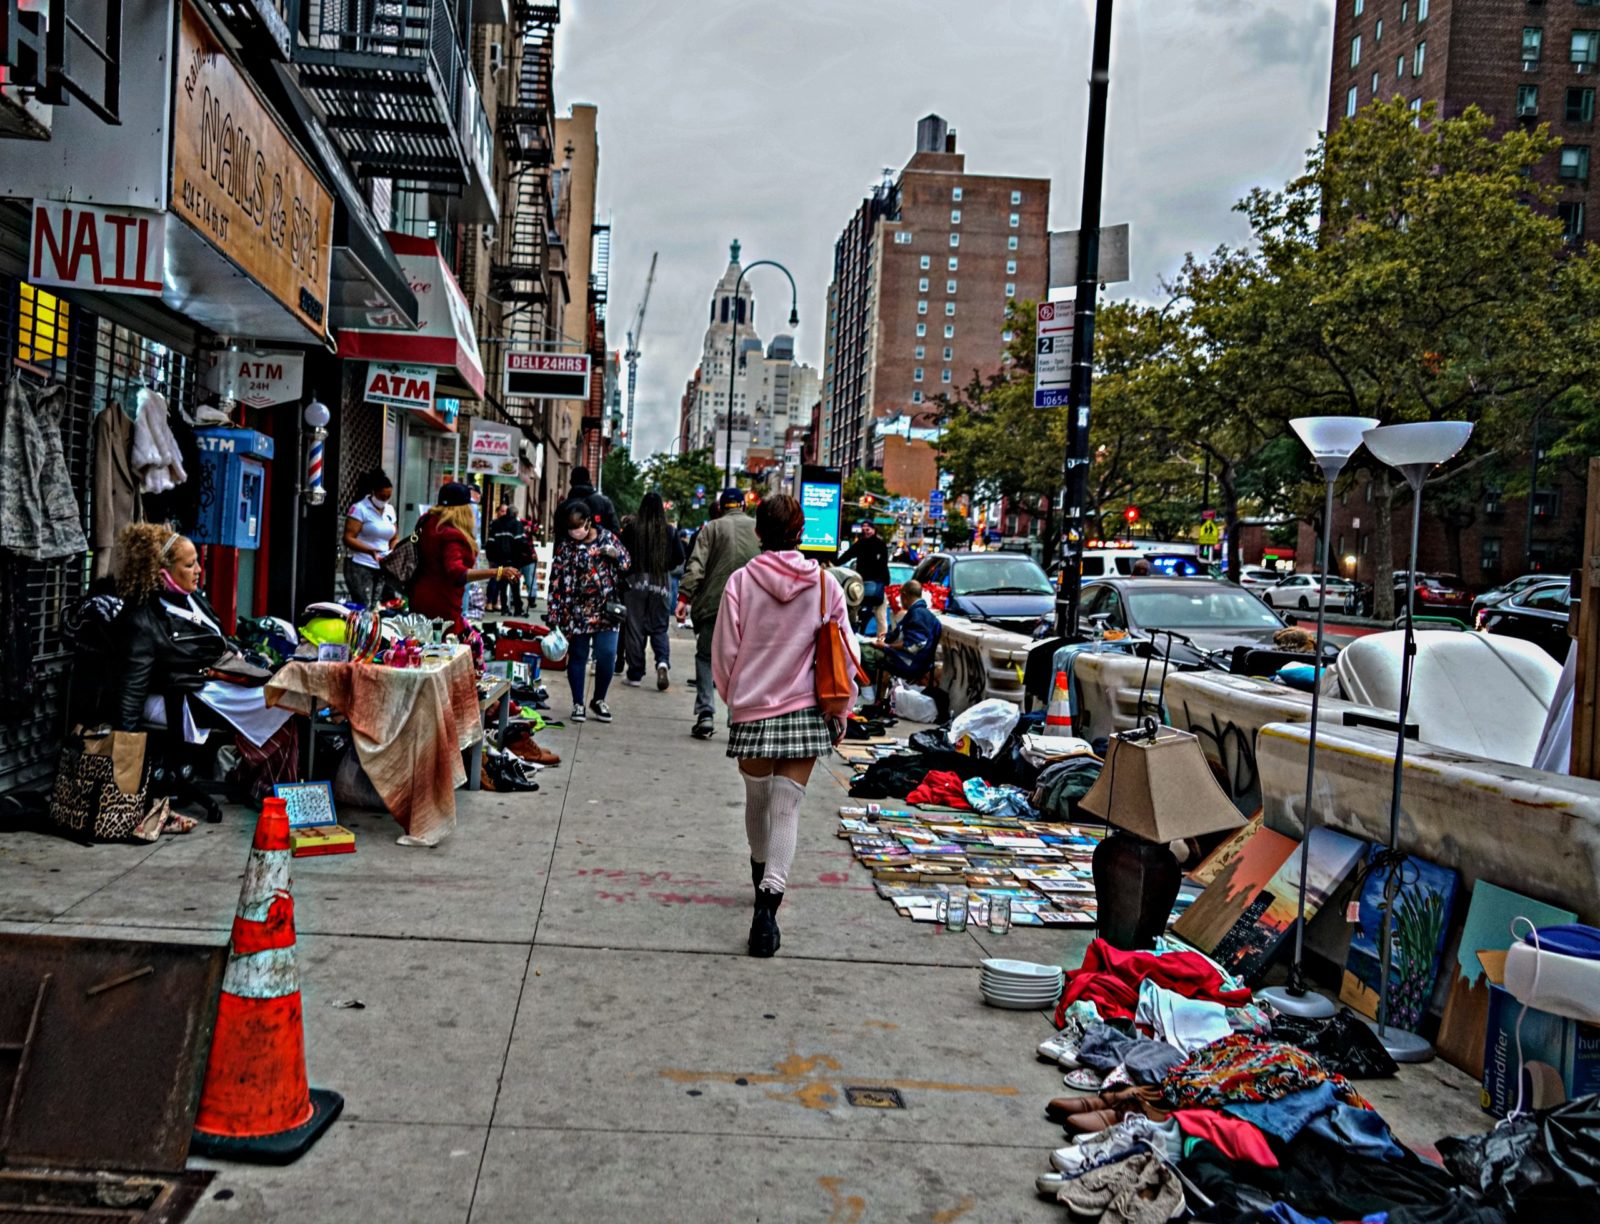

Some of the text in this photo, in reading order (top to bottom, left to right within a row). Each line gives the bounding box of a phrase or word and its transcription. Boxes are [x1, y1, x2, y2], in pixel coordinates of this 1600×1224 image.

[201, 85, 266, 226] NAILS
[270, 173, 286, 249] &
[291, 196, 320, 283] SPA
[182, 179, 195, 212] 424
[196, 191, 202, 219] E
[32, 206, 163, 291] NAIL
[1041, 338, 1050, 353] 2
[238, 361, 283, 380] ATM
[512, 355, 582, 371] DELI 24HRS
[249, 381, 270, 391] 24H
[368, 373, 430, 401] ATM
[1043, 395, 1068, 406] 10654
[196, 436, 235, 453] ATM
[474, 439, 509, 449] ATM
[1491, 1027, 1508, 1117] humidifier
